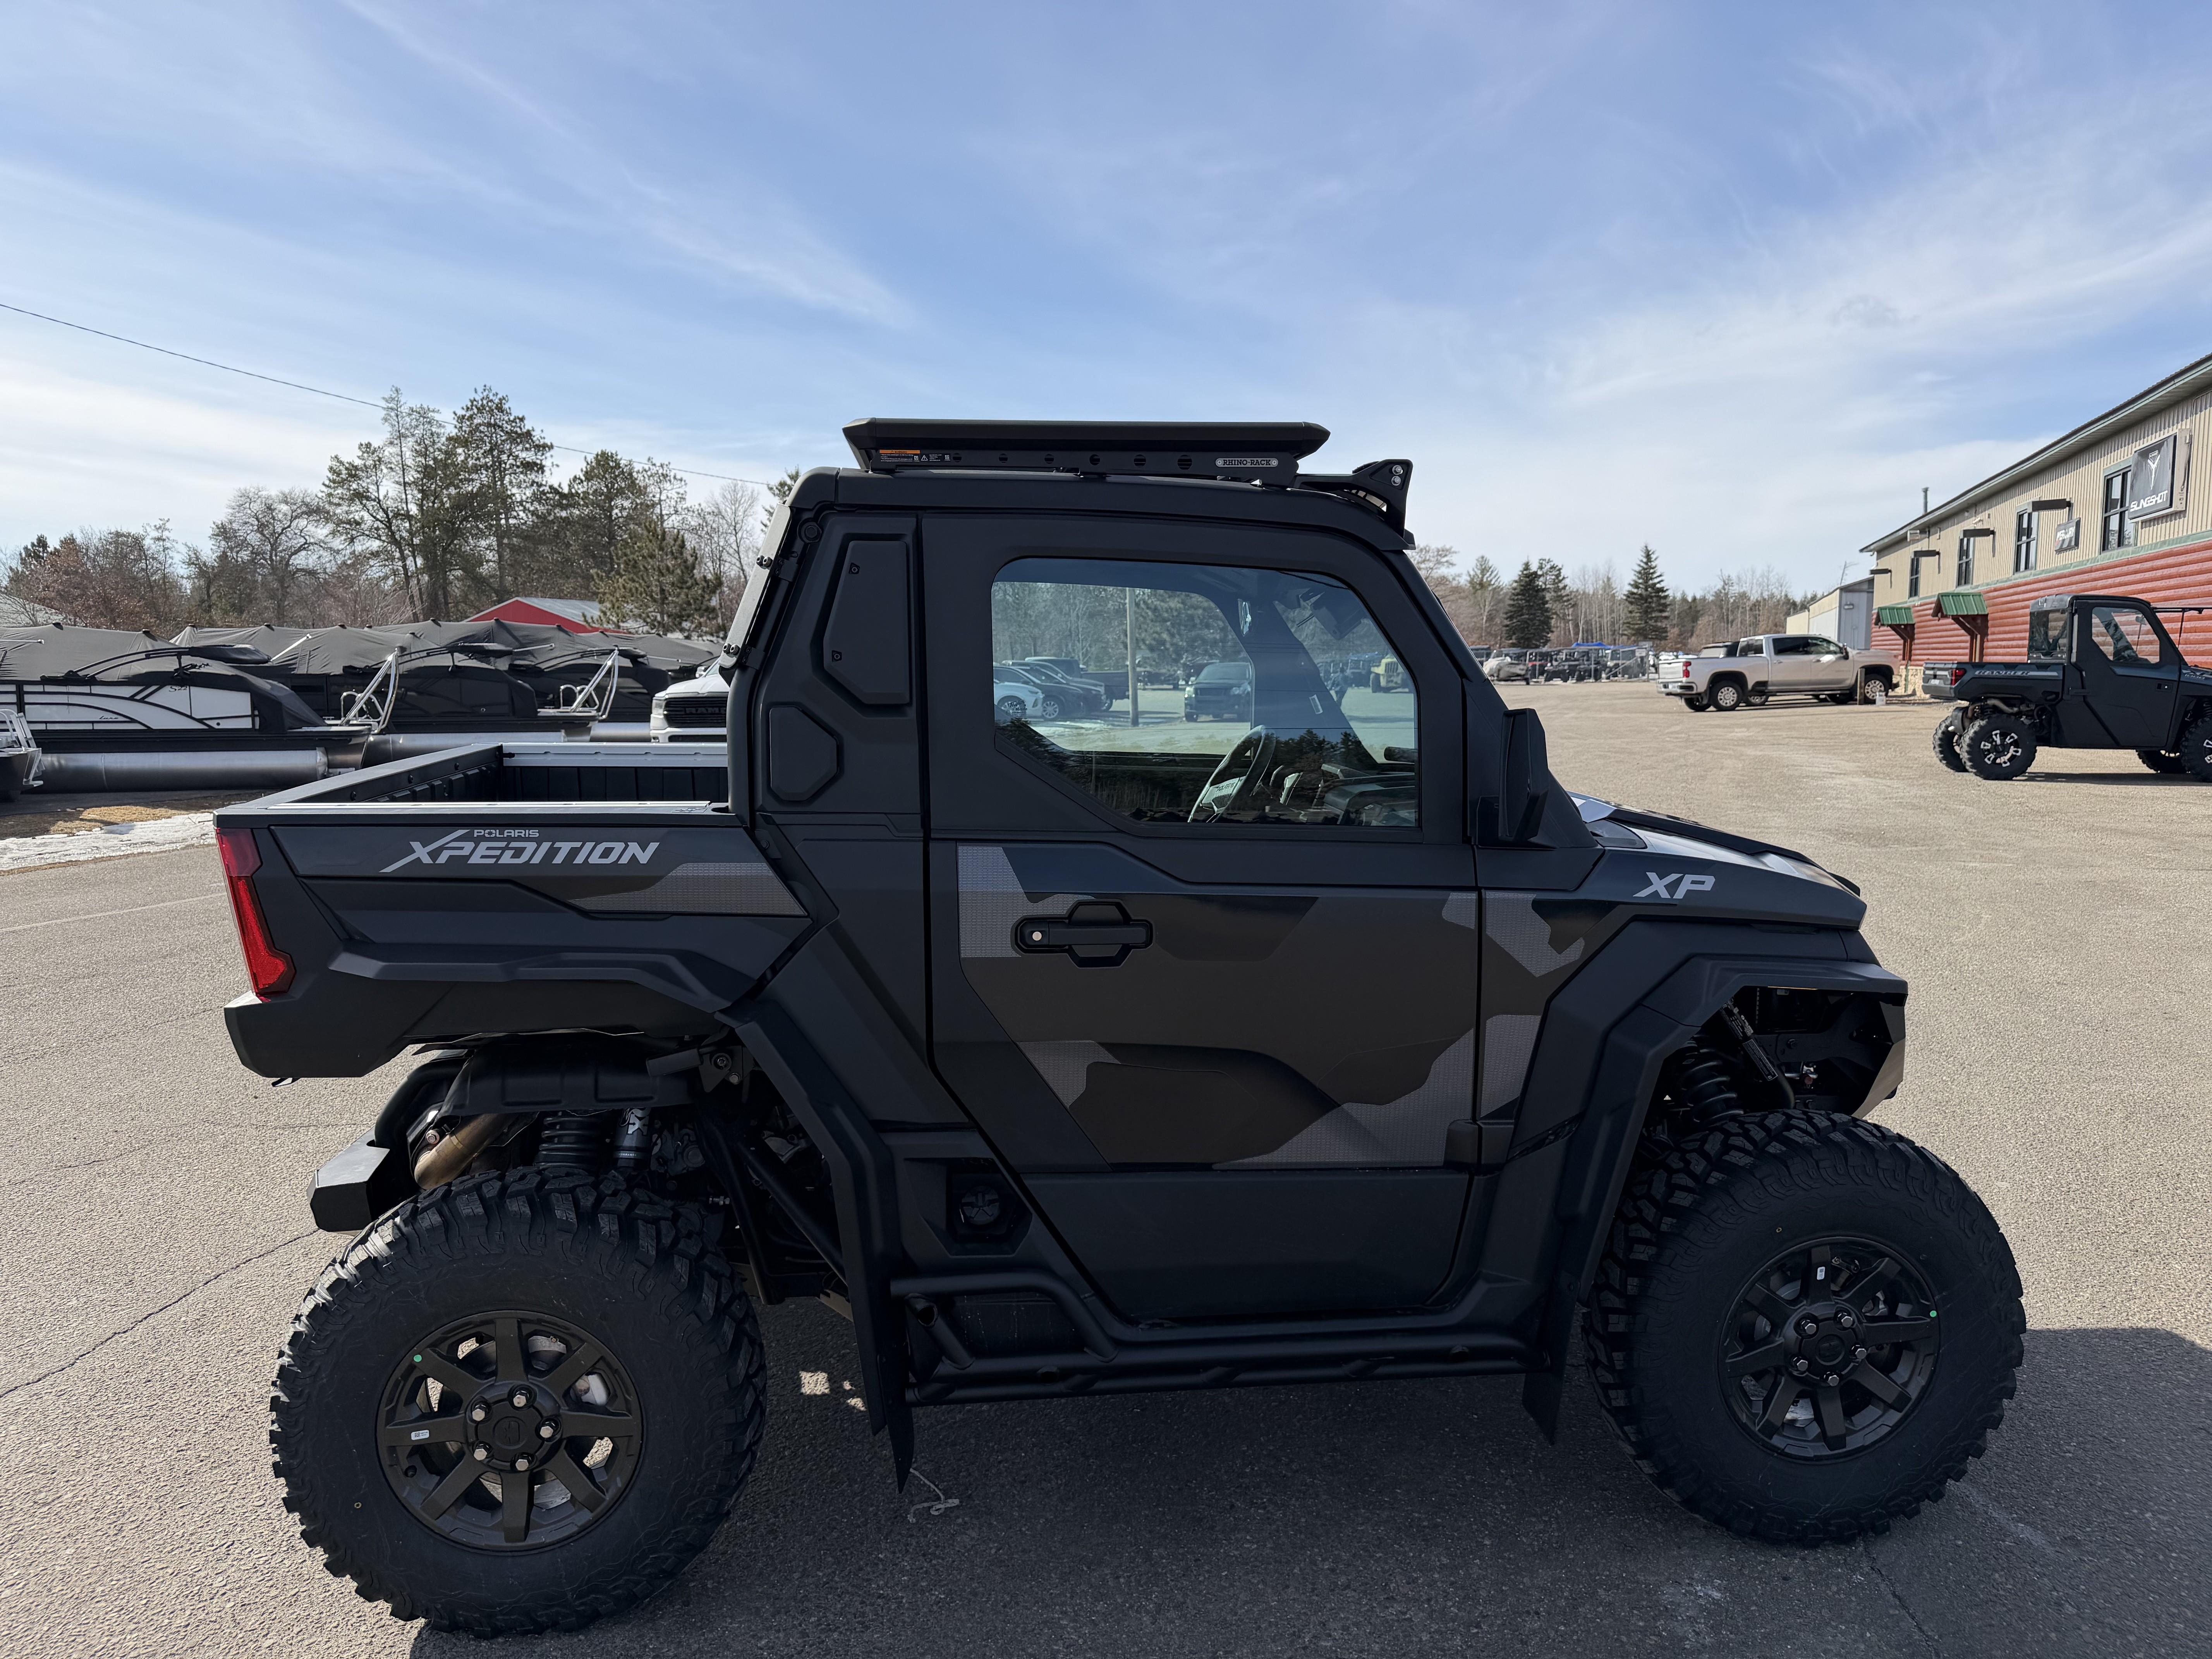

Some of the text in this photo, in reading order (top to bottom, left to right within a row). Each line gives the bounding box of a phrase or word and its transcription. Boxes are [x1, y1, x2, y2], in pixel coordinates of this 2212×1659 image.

[2130, 490, 2168, 512] SLINGSHOT
[474, 830, 539, 838] POLARIS
[379, 829, 660, 872] XPEDITION
[1633, 872, 1716, 899] XP
